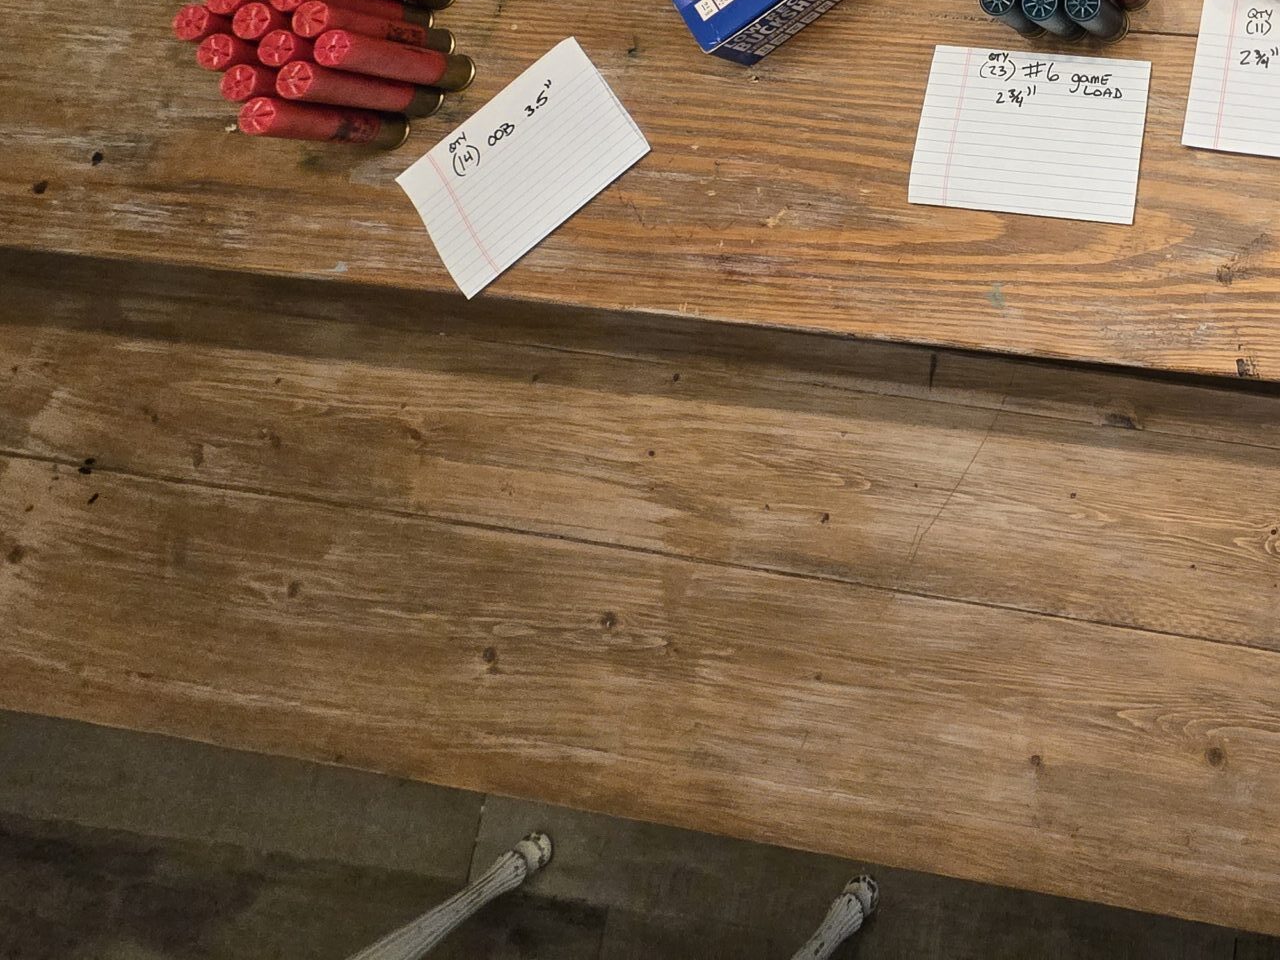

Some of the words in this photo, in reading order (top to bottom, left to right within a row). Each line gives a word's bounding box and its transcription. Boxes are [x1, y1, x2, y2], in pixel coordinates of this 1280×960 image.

[1247, 8, 1273, 20] QTY
[724, 23, 761, 48] LOW
[1246, 20, 1272, 35] (11)
[988, 52, 1009, 62] QTY
[979, 59, 1016, 82] (23)
[1022, 61, 1060, 82] #6
[1083, 85, 1123, 100] LOAD
[449, 131, 469, 154] QTY
[452, 144, 481, 177] (14)
